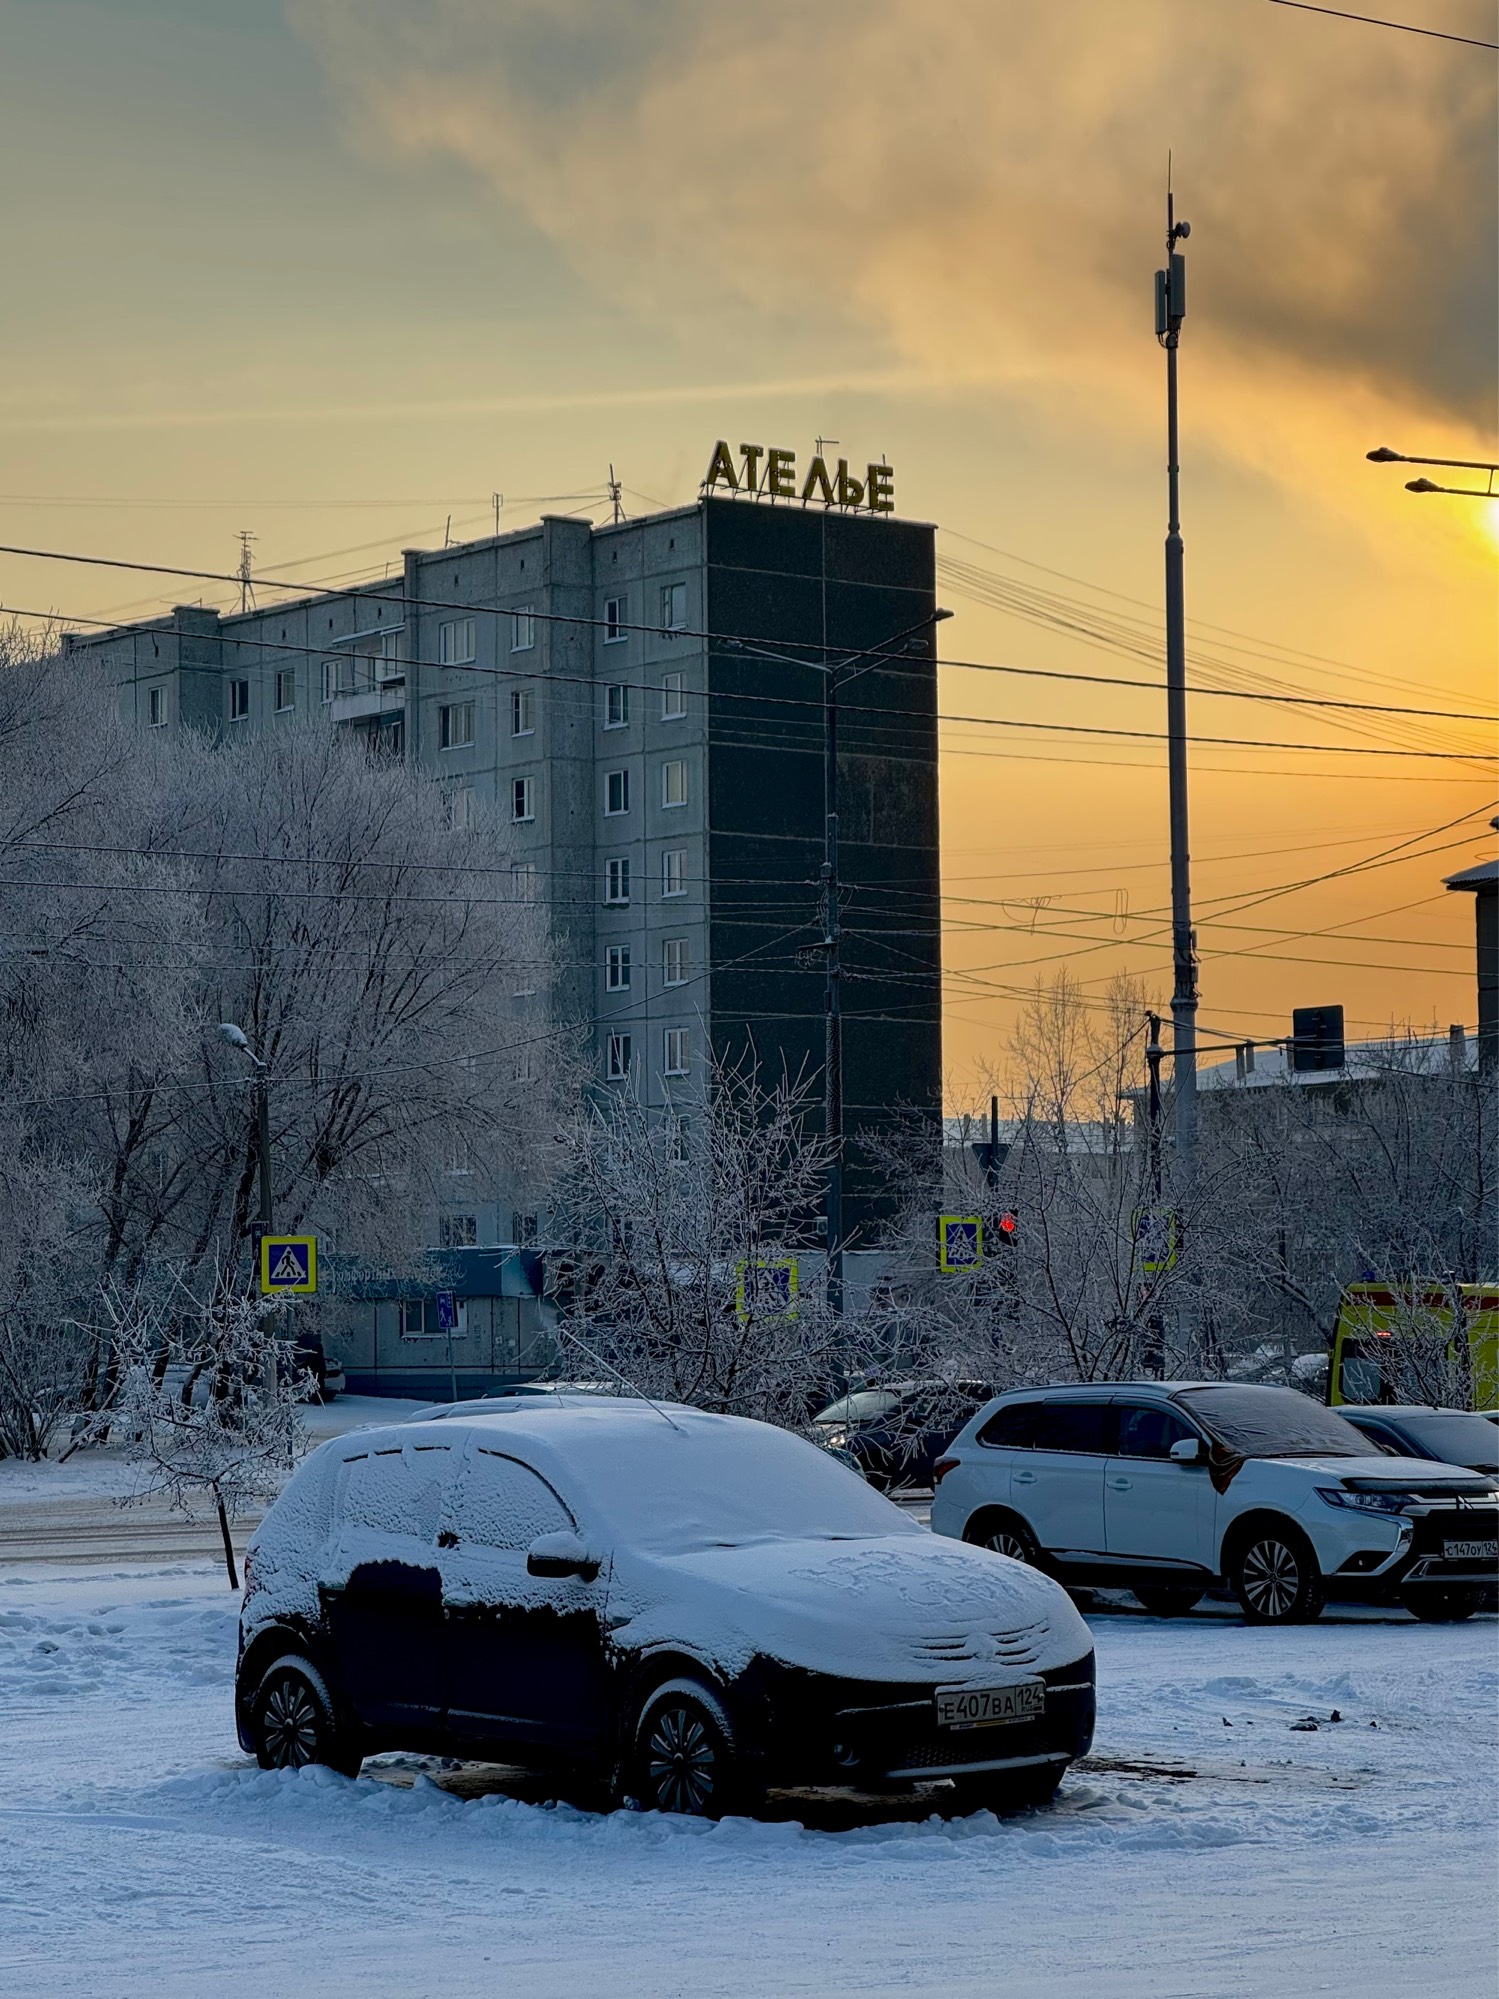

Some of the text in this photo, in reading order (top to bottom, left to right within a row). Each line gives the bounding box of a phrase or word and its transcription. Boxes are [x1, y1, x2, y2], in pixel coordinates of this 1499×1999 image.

[706, 440, 894, 511] АТЕЛЬЕ
[944, 1686, 1041, 1720] Е407ВА 124
